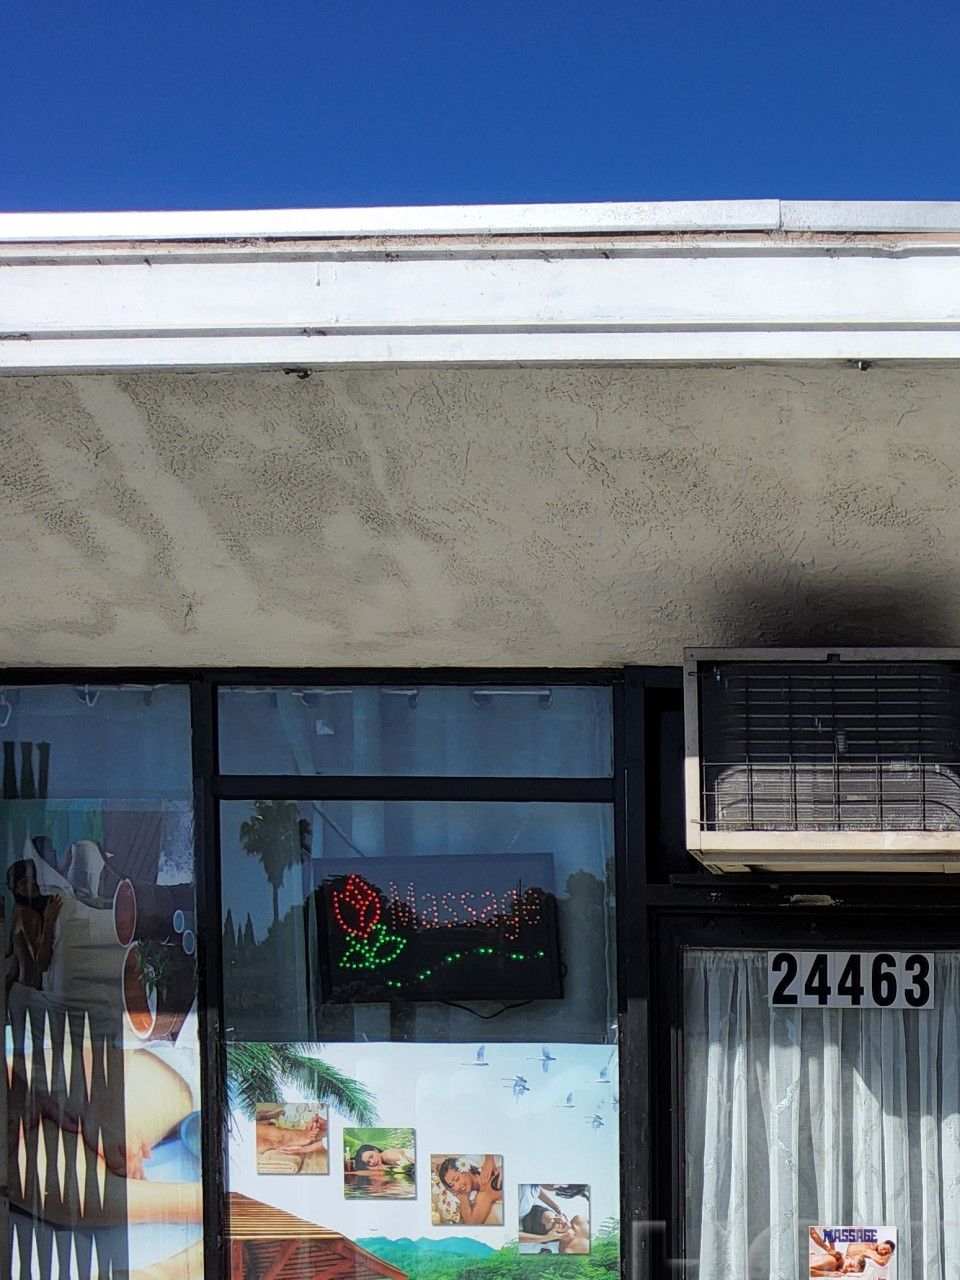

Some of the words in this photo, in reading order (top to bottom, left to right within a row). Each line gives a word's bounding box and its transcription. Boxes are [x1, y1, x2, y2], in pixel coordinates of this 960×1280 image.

[389, 881, 541, 940] Massage
[771, 952, 931, 1008] 24463
[823, 1228, 878, 1243] MASSAGE
